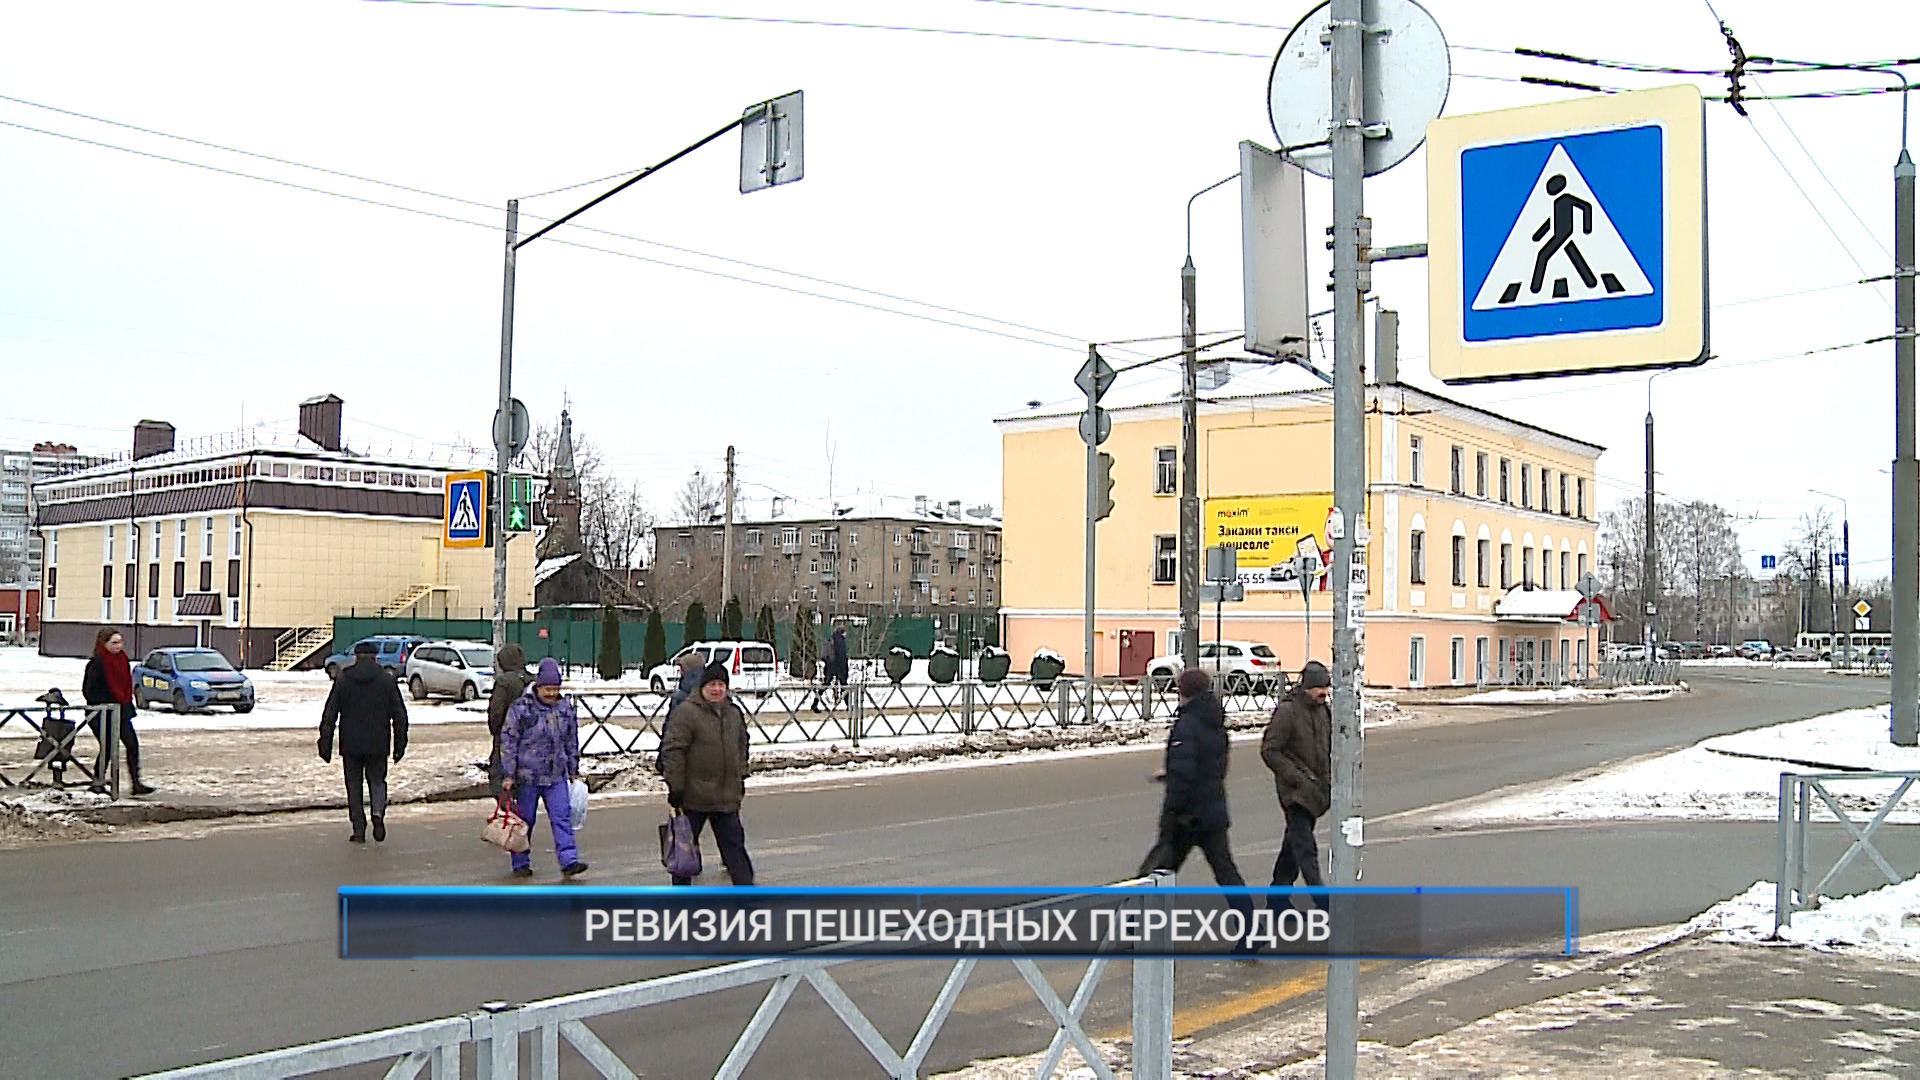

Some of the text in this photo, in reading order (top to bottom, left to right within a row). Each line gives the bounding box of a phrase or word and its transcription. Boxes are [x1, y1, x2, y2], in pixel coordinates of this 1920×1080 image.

[1217, 507, 1248, 518] maxim
[1218, 525, 1299, 537] Закажи такси
[1238, 573, 1265, 584] 55 55
